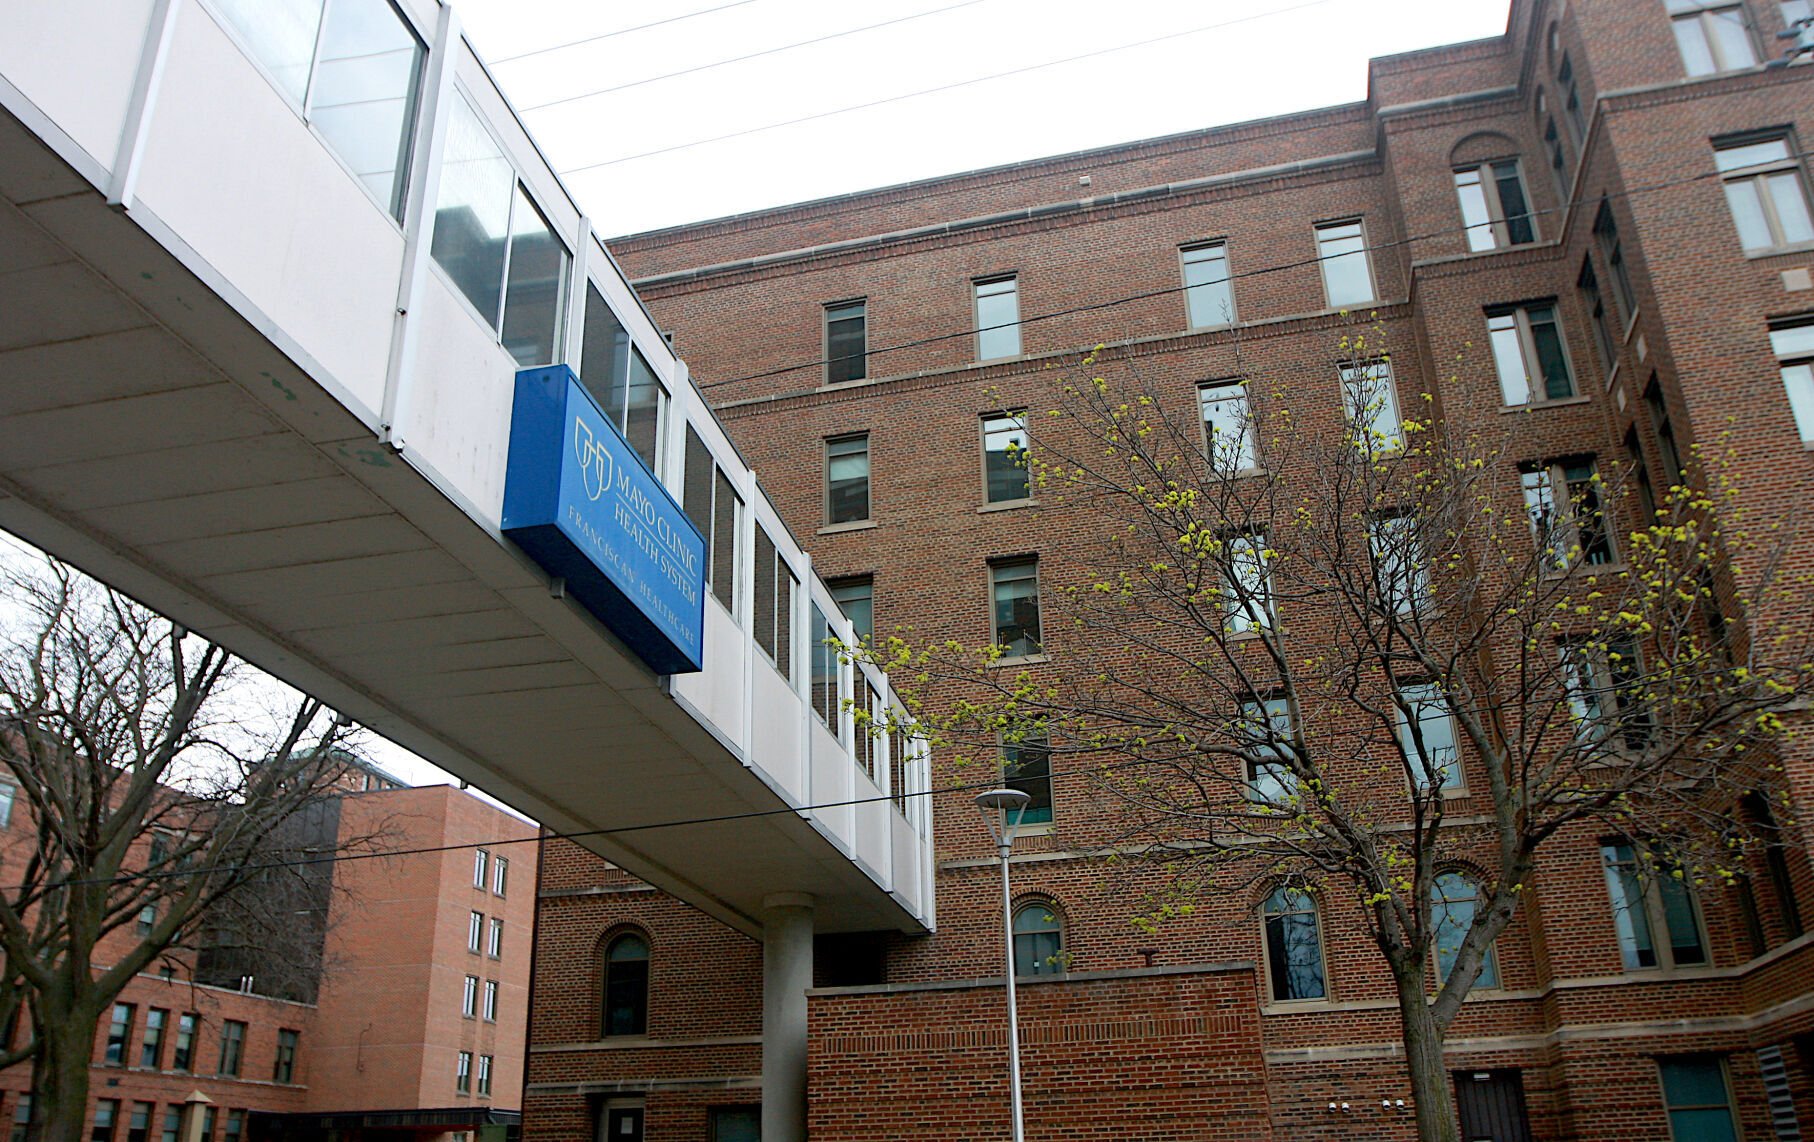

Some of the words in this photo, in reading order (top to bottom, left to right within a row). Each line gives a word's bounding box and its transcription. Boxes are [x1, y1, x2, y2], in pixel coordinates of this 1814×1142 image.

[568, 504, 634, 583] FRANCISCAN
[639, 580, 695, 646] HEALTHCARE
[614, 502, 659, 565] HEALTH
[660, 557, 696, 608] SYSTEM
[616, 465, 656, 526] MAYO
[657, 516, 697, 577] CLINIC
